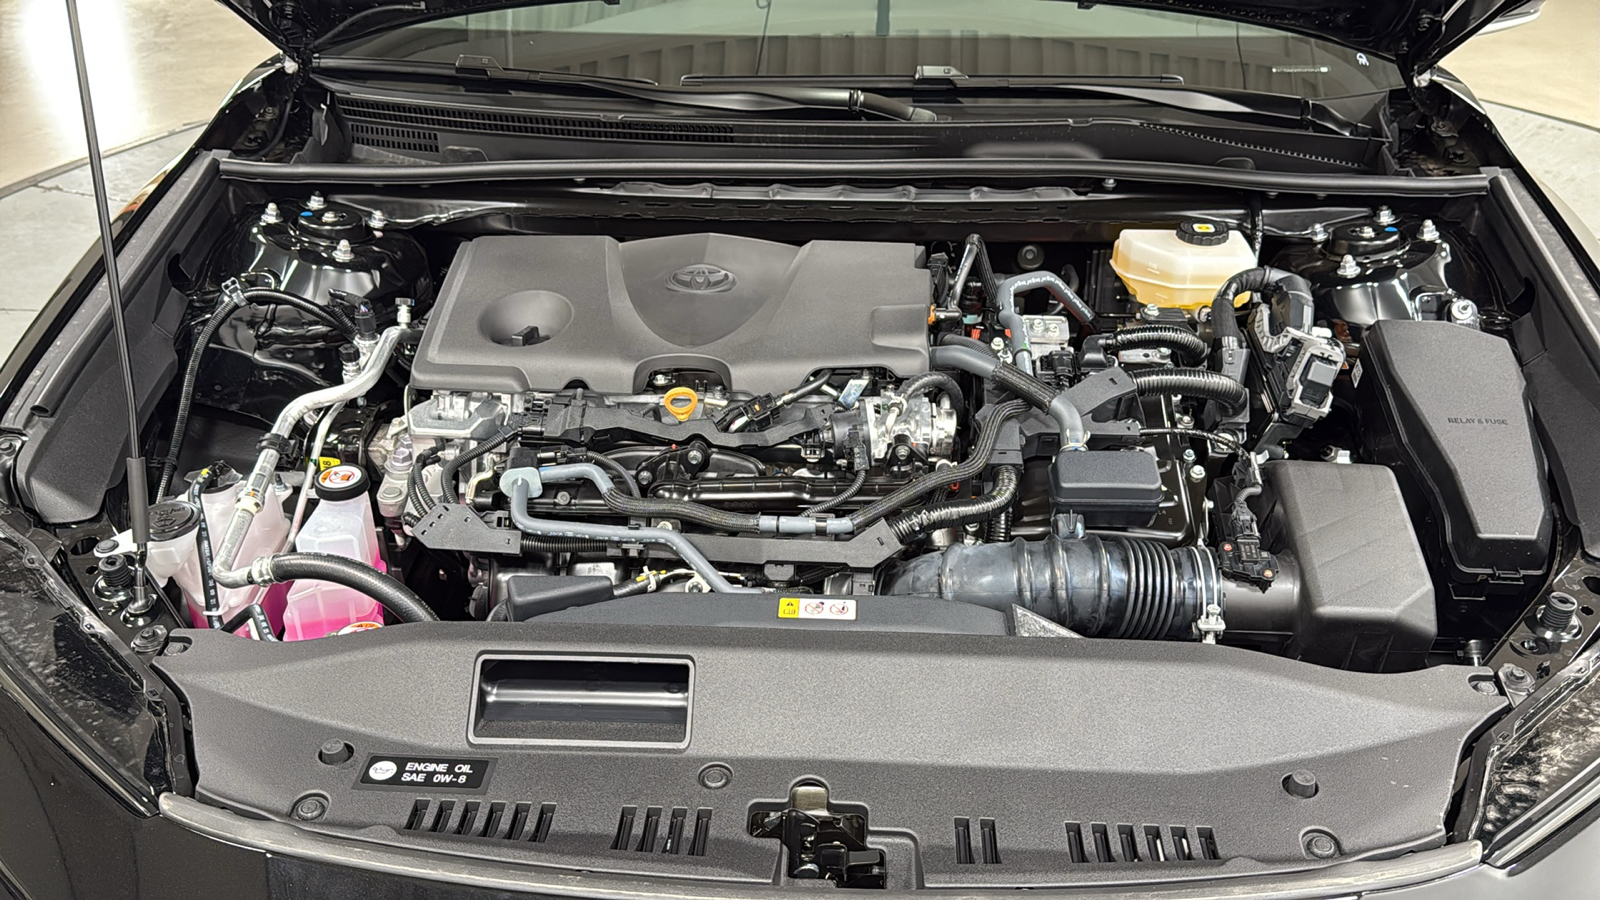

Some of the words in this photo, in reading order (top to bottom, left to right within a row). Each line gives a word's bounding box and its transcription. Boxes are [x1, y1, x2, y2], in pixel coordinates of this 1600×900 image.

[1485, 418, 1509, 426] FUSE
[405, 762, 448, 772] ENGINE
[454, 764, 473, 774] OIL
[401, 773, 426, 783] SAE
[432, 774, 467, 784] 0W-8
